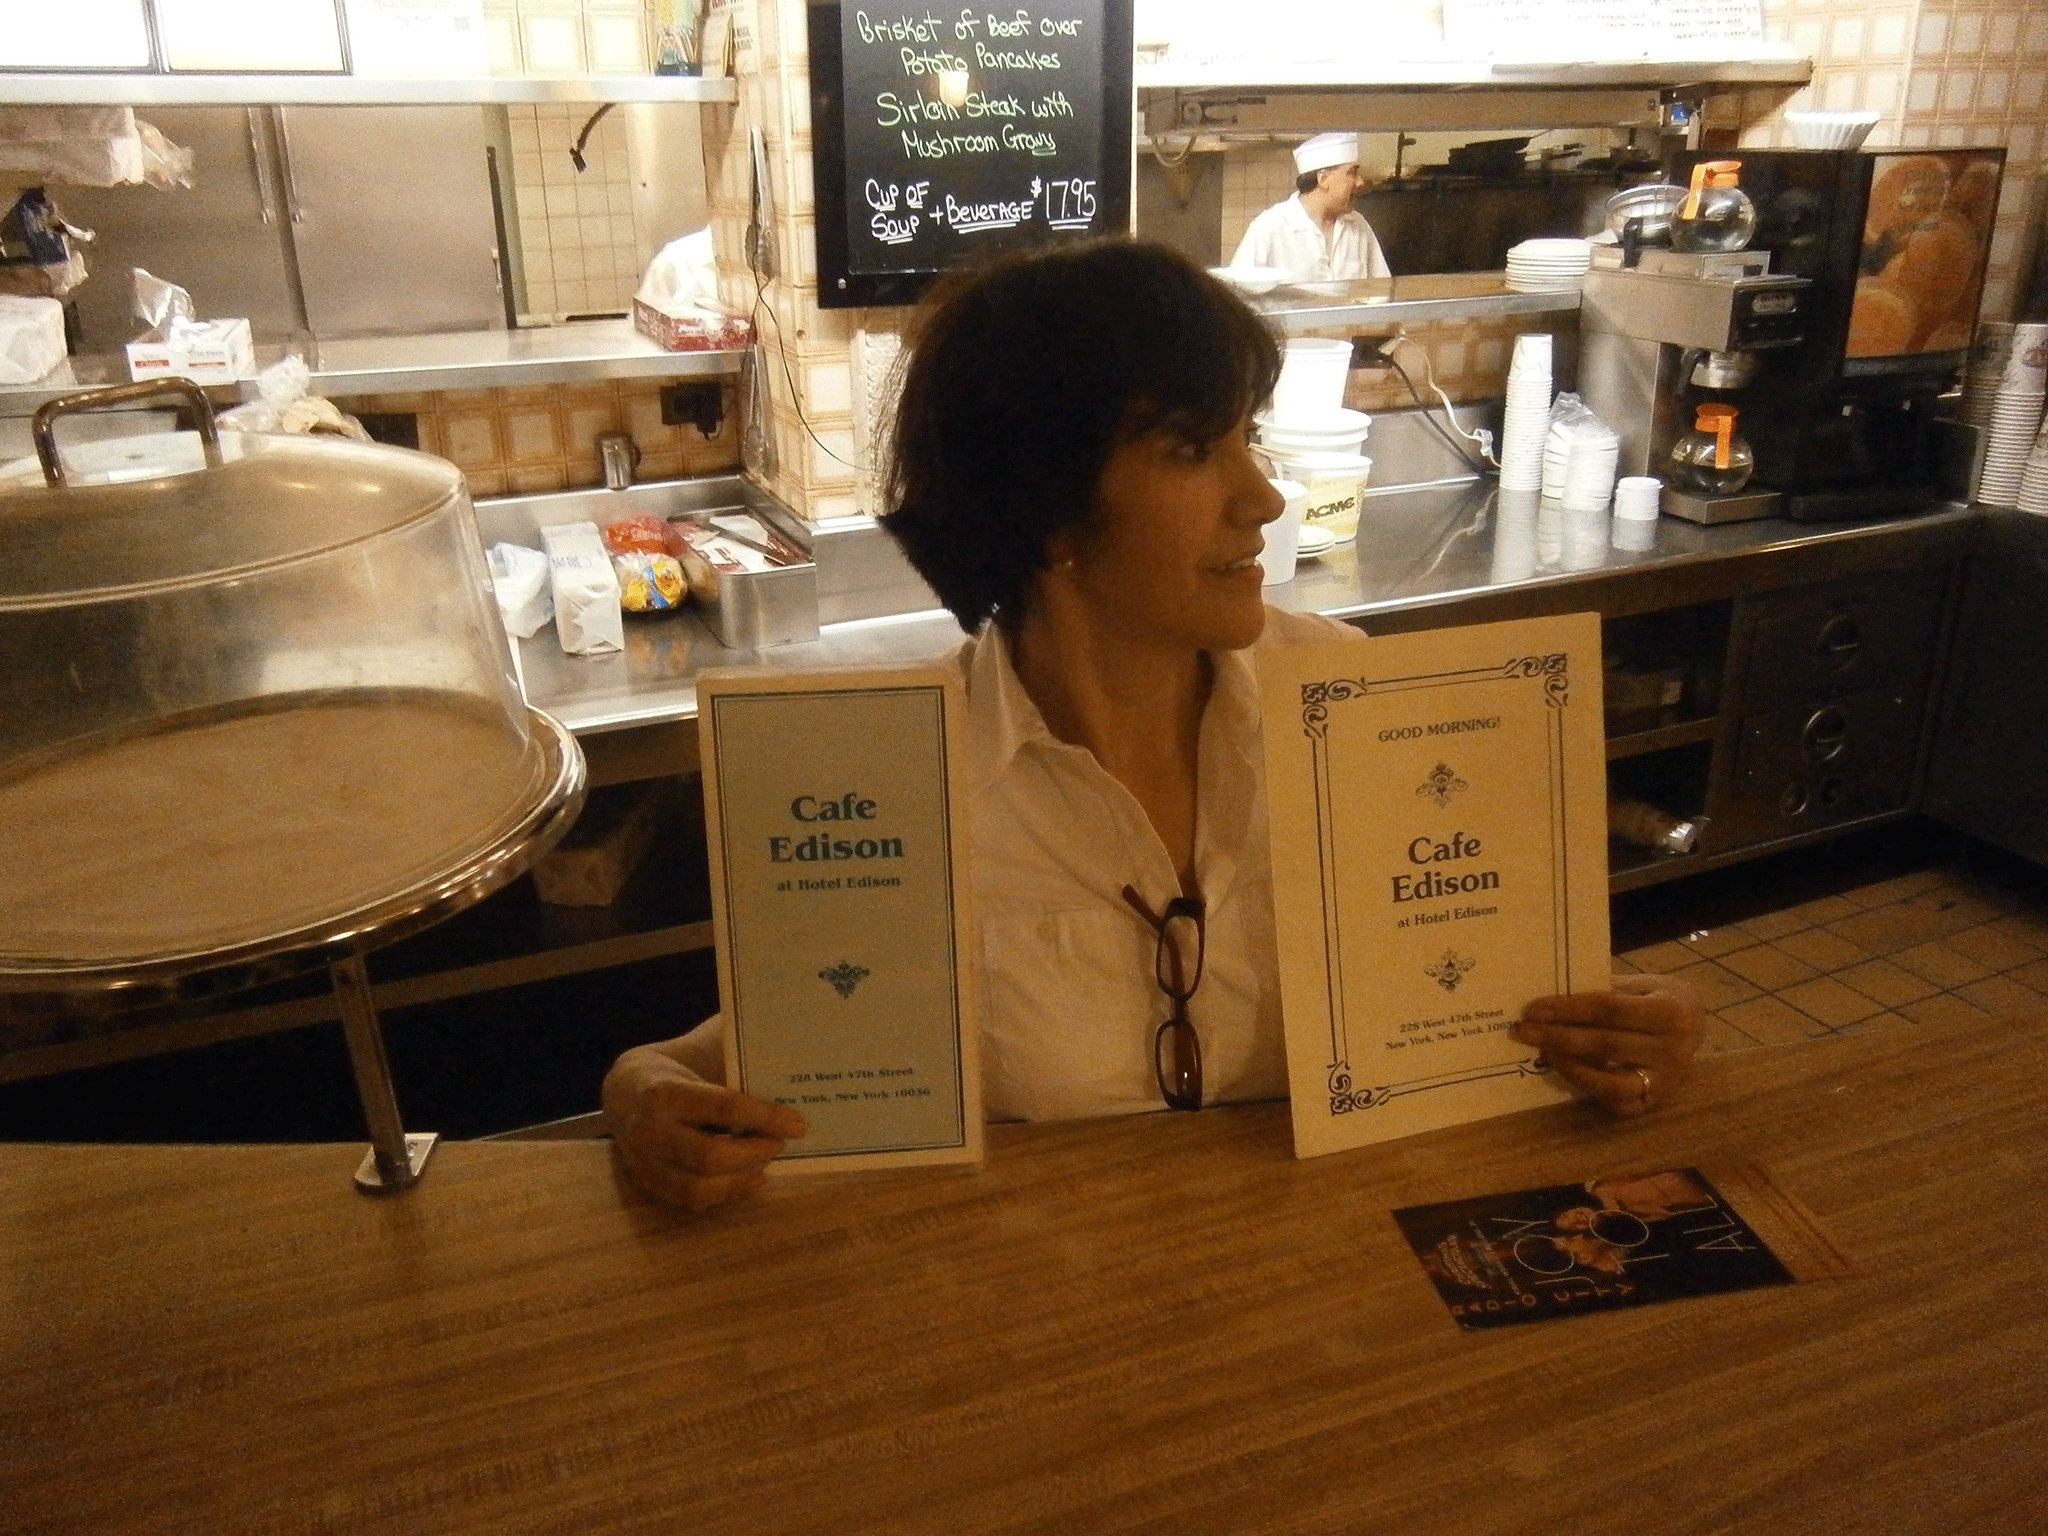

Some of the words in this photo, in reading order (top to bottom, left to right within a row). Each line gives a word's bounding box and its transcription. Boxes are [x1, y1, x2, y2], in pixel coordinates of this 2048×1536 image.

[857, 10, 942, 43] Brisket
[955, 8, 980, 39] of
[987, 10, 1032, 37] Beef
[900, 46, 968, 76] Potato
[975, 42, 1061, 70] Pancakes
[877, 90, 959, 126] Sirloin
[965, 92, 1026, 118] Steak
[1032, 91, 1073, 118] with
[901, 129, 999, 159] Mushroom
[1002, 124, 1056, 150] Gravy
[906, 182, 930, 205] OF
[1305, 497, 1355, 521] ACME
[1378, 726, 1423, 742] GOOD
[1427, 716, 1501, 737] MORNING!
[791, 793, 877, 823] Cafe
[769, 831, 904, 862] Edison
[1407, 832, 1481, 864] Cafe
[777, 879, 792, 891] at
[797, 877, 841, 891] Hotel
[847, 875, 901, 888] Edison
[1391, 869, 1500, 903] Edison
[1397, 915, 1410, 929] at
[1414, 909, 1450, 927] Hotel
[1453, 904, 1498, 921] Edison
[1399, 1022, 1419, 1033] 228
[1423, 1018, 1445, 1029] West
[1449, 1013, 1472, 1024] 47th
[1475, 1009, 1504, 1019] Street
[1386, 1041, 1406, 1051] New
[1409, 1035, 1435, 1045] York,
[1437, 1032, 1457, 1041] New
[1461, 1025, 1484, 1037] York
[815, 1072, 842, 1081] West
[848, 1070, 874, 1079] 47th
[879, 1067, 913, 1077] Street
[802, 1095, 832, 1104] York,
[835, 1093, 858, 1101] New
[863, 1091, 889, 1099] York
[894, 1088, 930, 1097] 10036
[1667, 1194, 1757, 1251] ALL
[1490, 1218, 1596, 1286] JOY
[1589, 1209, 1670, 1276] TO
[1451, 1293, 1537, 1315] RADIO
[1554, 1283, 1635, 1303] CITY
